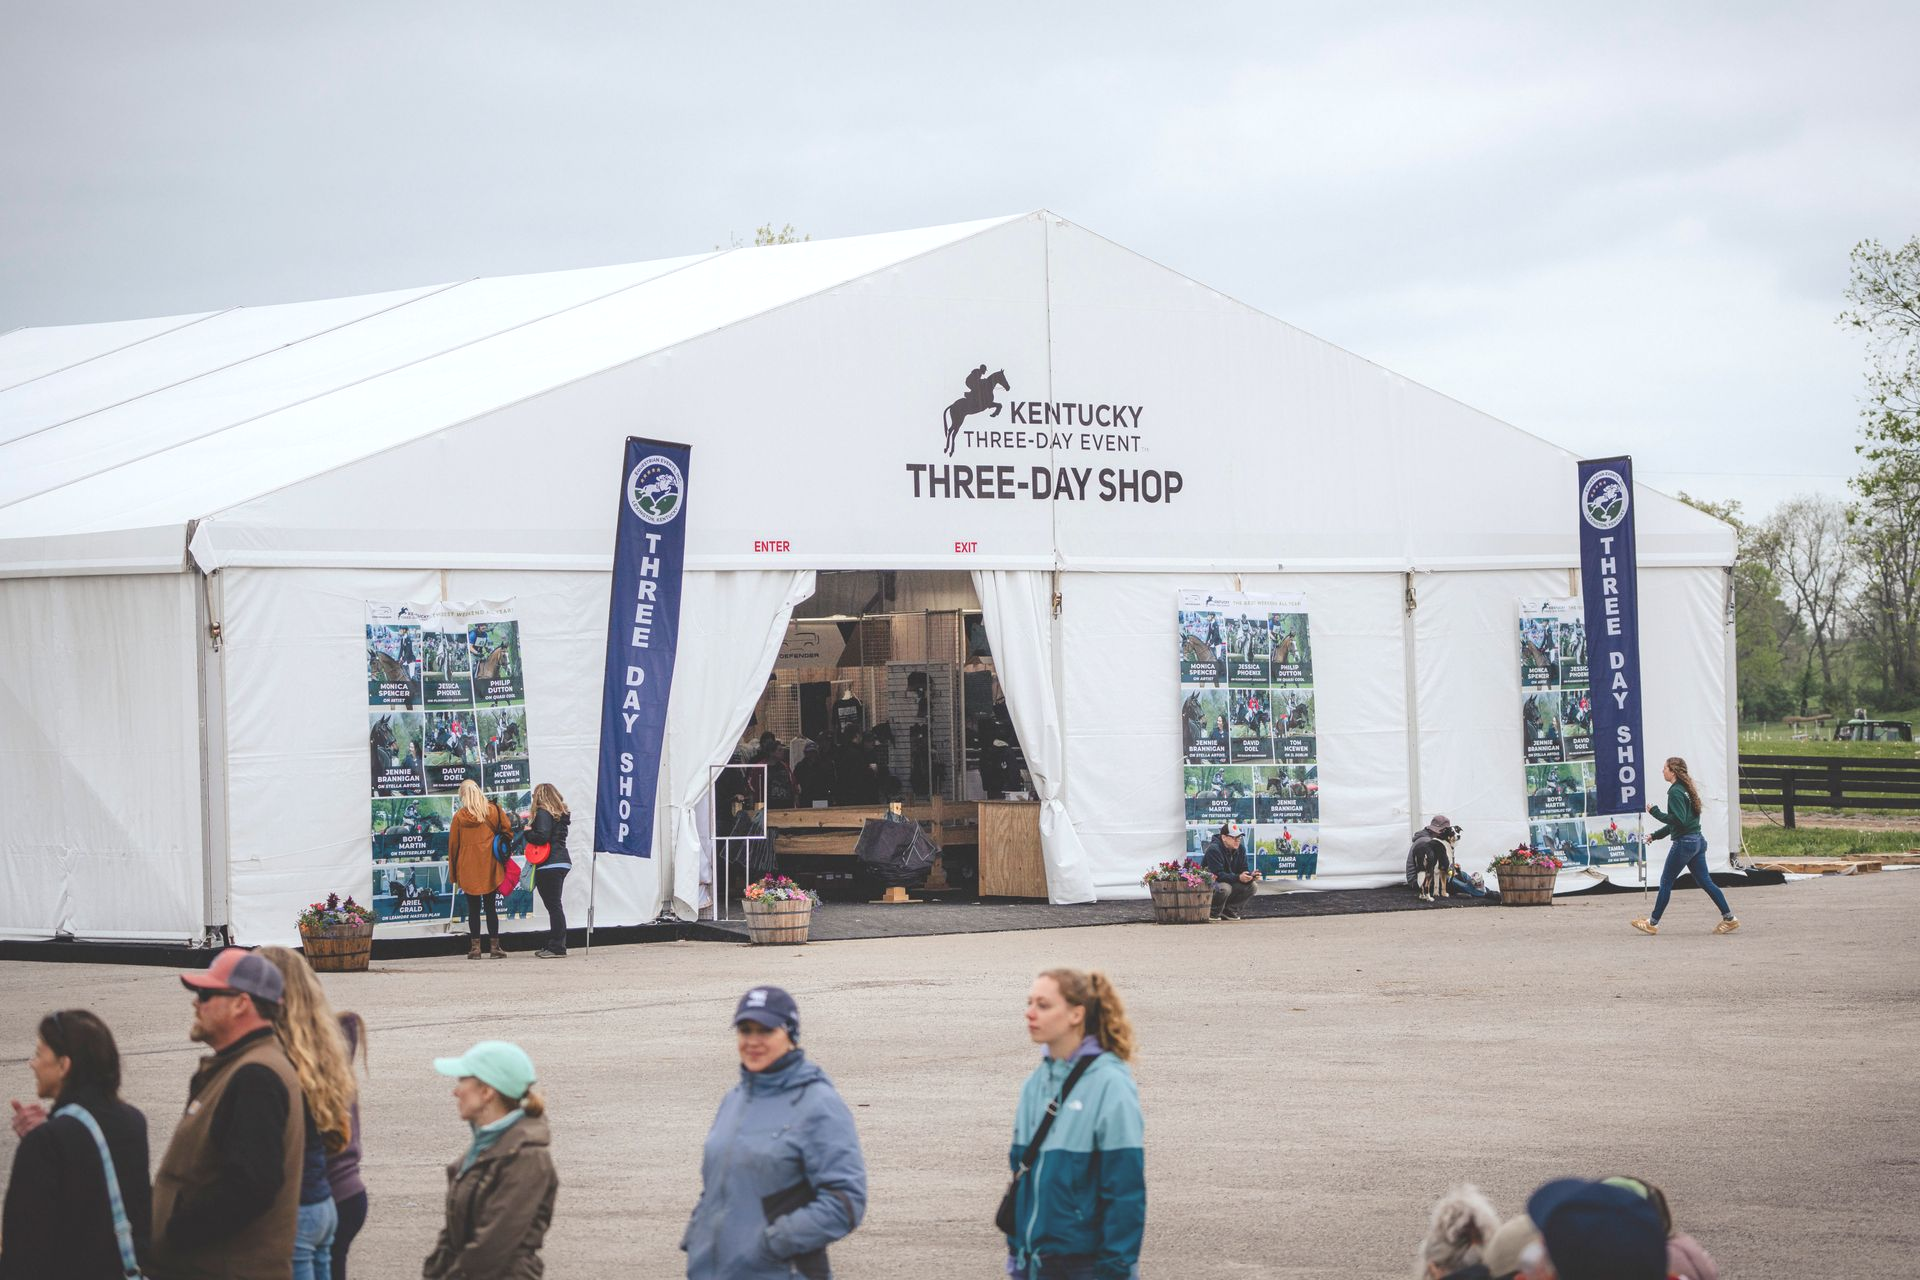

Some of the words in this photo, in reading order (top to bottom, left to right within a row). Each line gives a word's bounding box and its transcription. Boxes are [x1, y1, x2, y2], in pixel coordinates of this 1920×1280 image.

[1010, 401, 1143, 428] KENTUCKY
[963, 430, 1073, 450] THREE-DAY
[1081, 433, 1141, 453] EVENT
[906, 463, 1093, 501] THREE-DAY
[1098, 468, 1183, 504] SHOP
[754, 540, 790, 552] ENTER
[954, 541, 978, 553] EXIT
[631, 532, 662, 649] THREE
[1600, 536, 1622, 636] THREE
[490, 679, 511, 687] PHILIP
[1609, 651, 1628, 710] DAY
[436, 689, 462, 697] PHOENIX
[622, 665, 645, 734] DAY
[1617, 725, 1636, 804] SHOP
[442, 767, 466, 775] DAVID
[494, 770, 520, 778] MCEWEN
[377, 775, 420, 783] BRANNIGAN
[617, 752, 634, 843] SHOP
[402, 835, 423, 843] BOYD
[398, 842, 427, 850] MARTIN
[399, 905, 423, 913] GRALD
